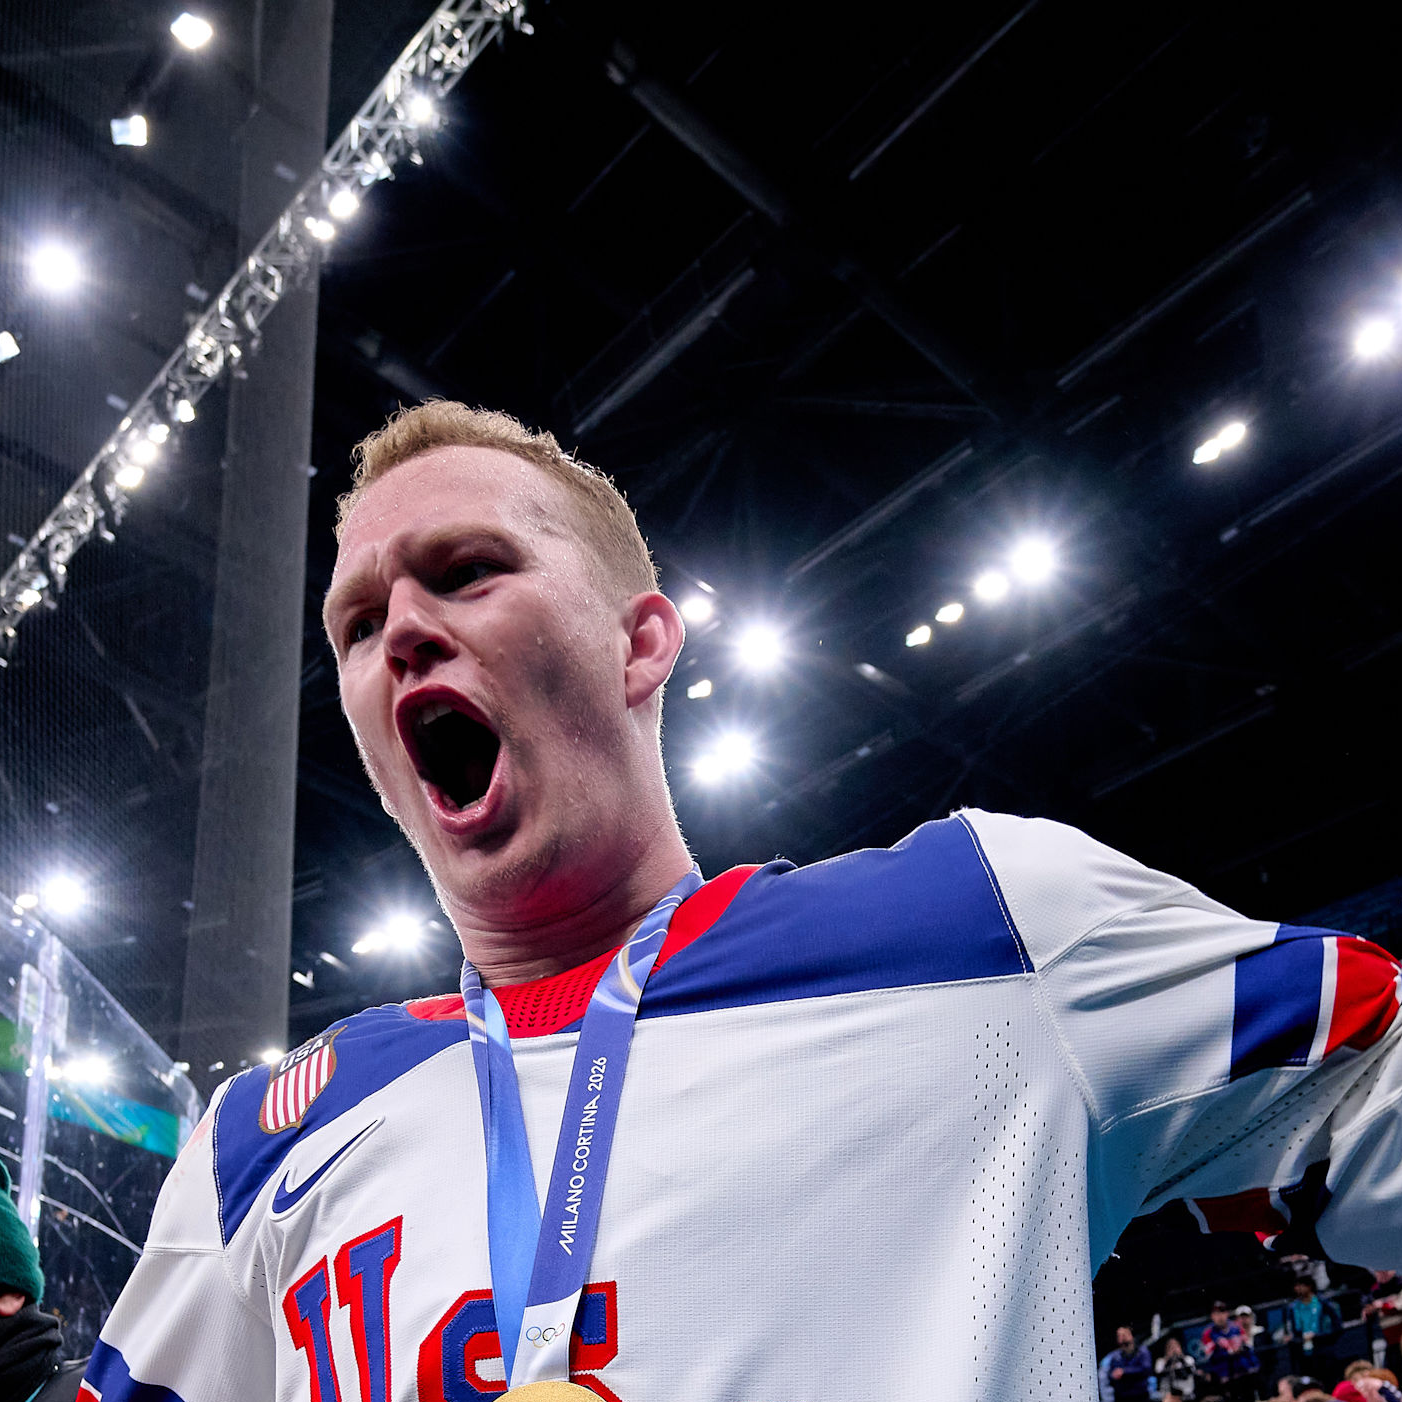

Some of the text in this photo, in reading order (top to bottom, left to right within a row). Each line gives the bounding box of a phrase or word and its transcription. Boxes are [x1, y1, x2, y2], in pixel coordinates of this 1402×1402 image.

[279, 1038, 323, 1073] USA
[558, 1056, 608, 1256] MILANO CORTINA 2026
